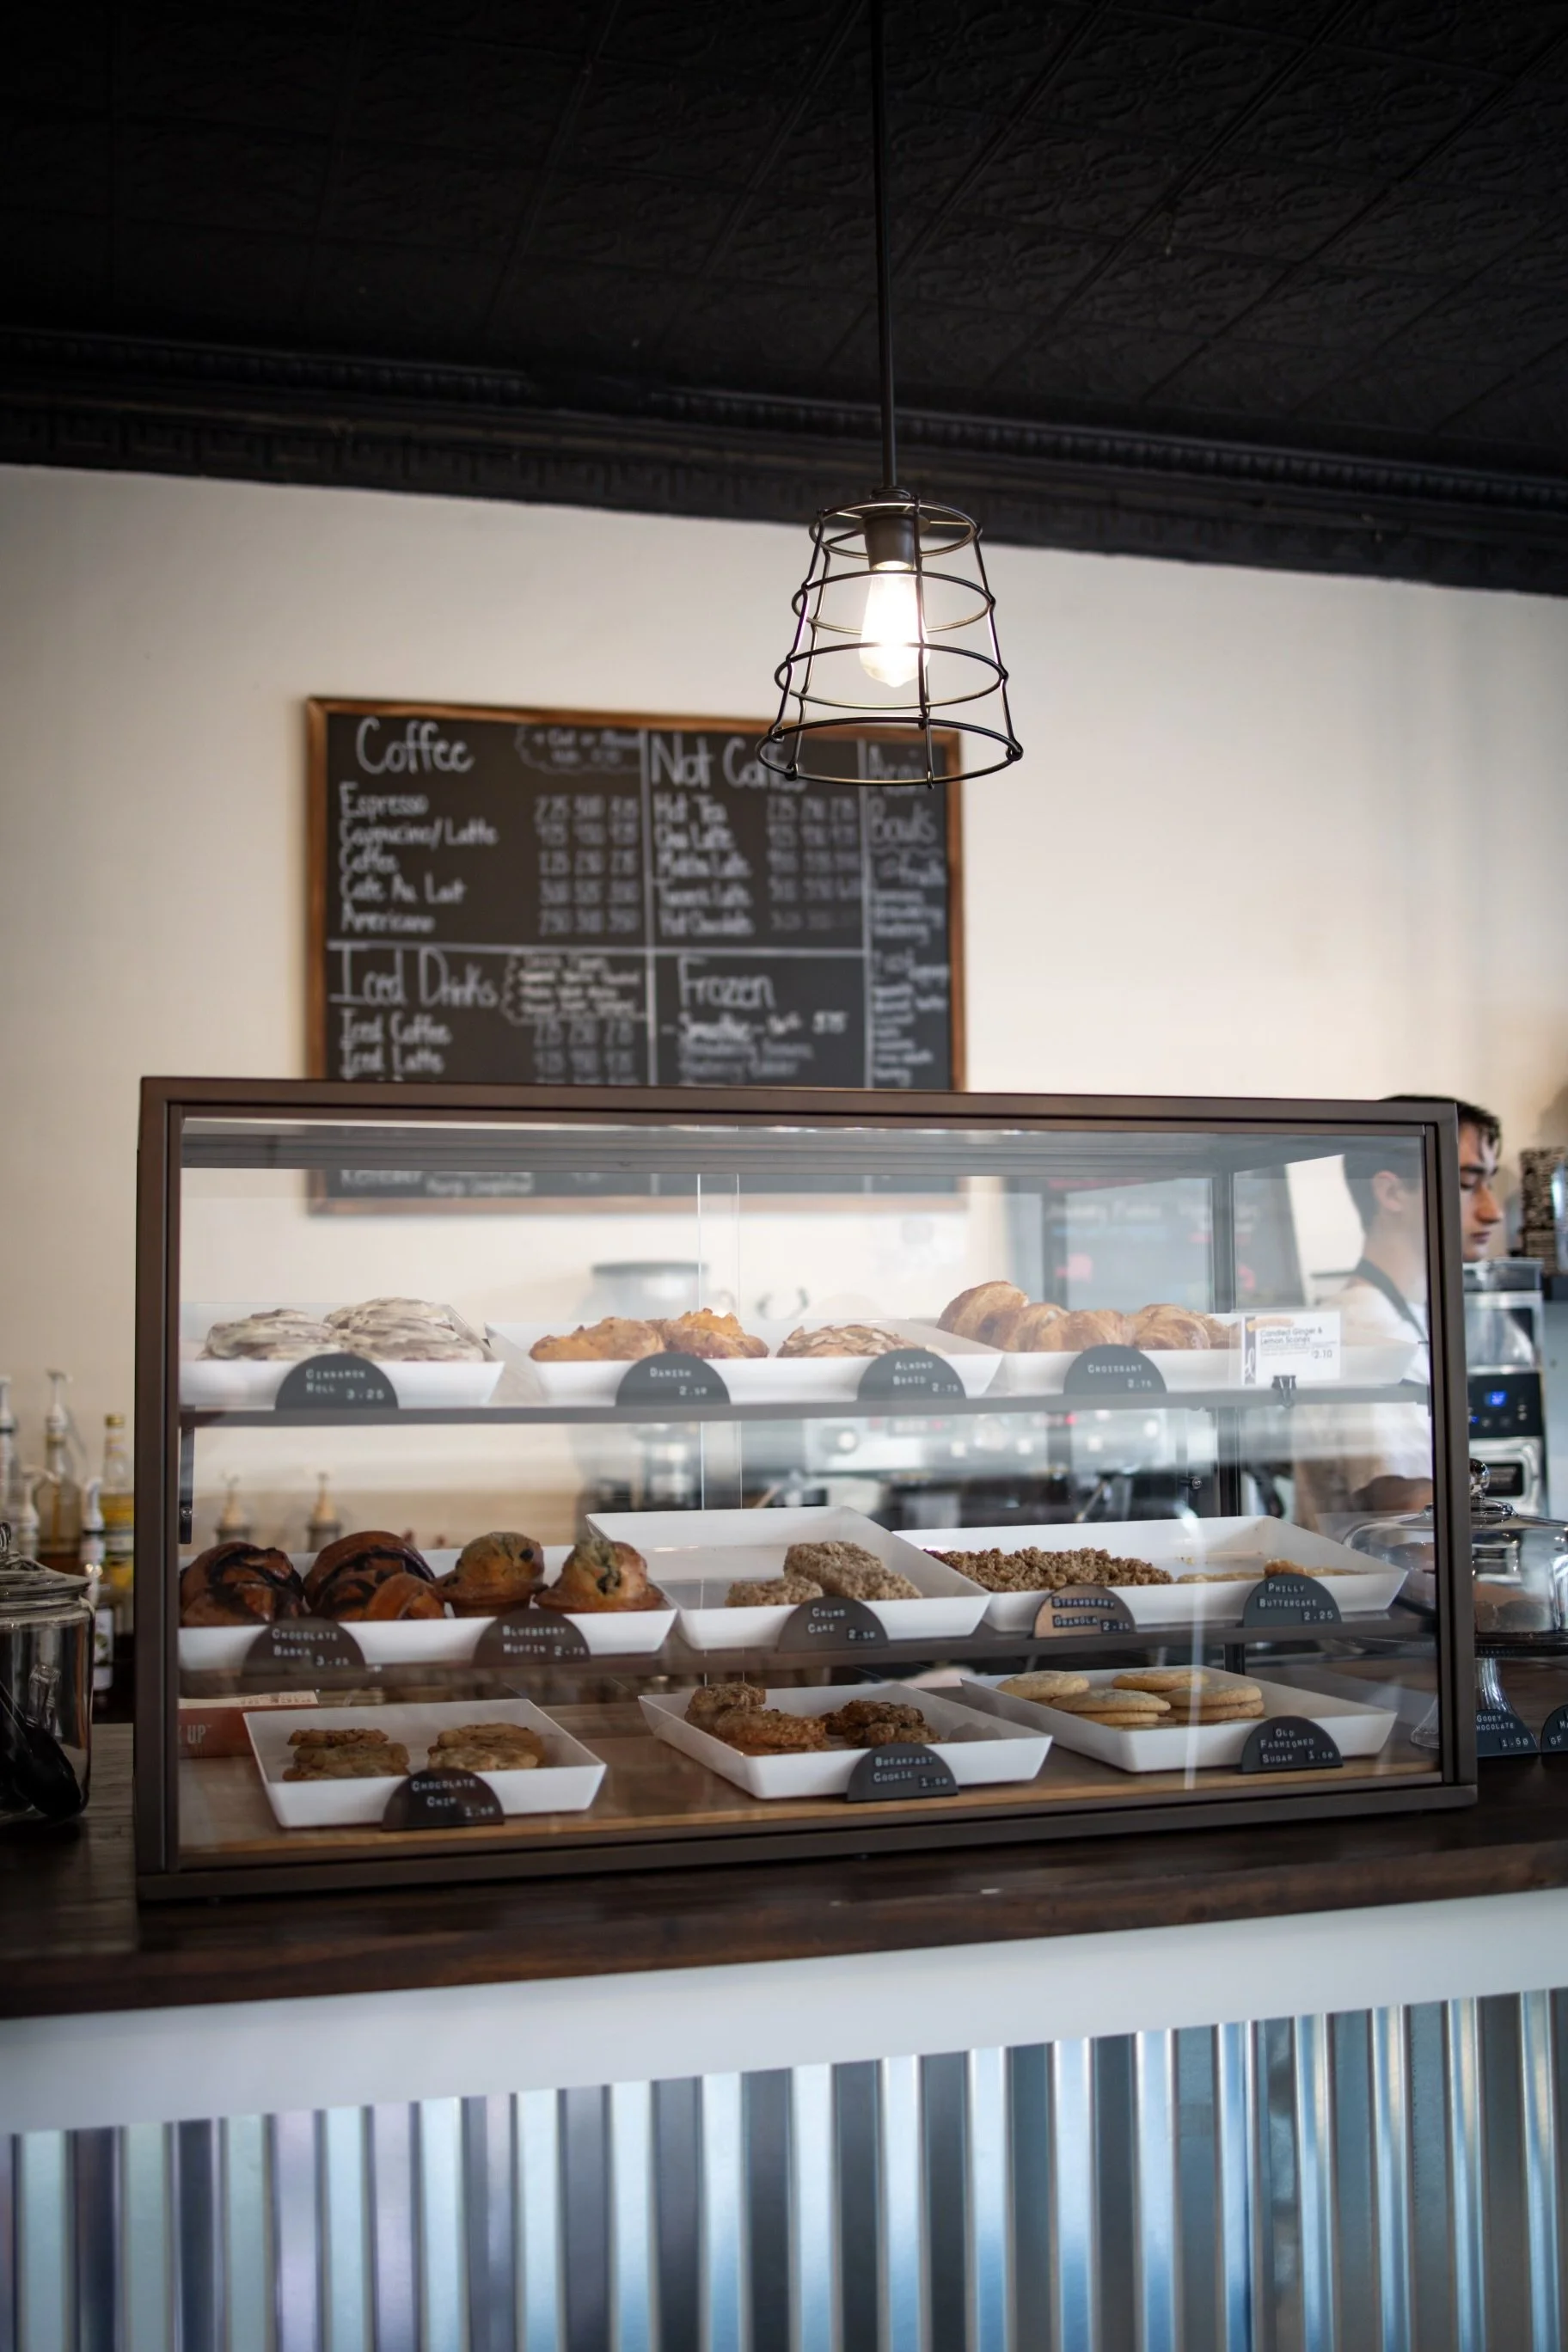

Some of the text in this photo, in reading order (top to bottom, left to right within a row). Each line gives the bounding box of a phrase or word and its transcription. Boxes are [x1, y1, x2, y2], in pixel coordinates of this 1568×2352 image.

[357, 716, 475, 774] Coffee
[651, 732, 713, 789] Not
[340, 781, 429, 822] Espresso
[418, 946, 499, 1008] Drinks
[677, 955, 776, 1010] Frozen
